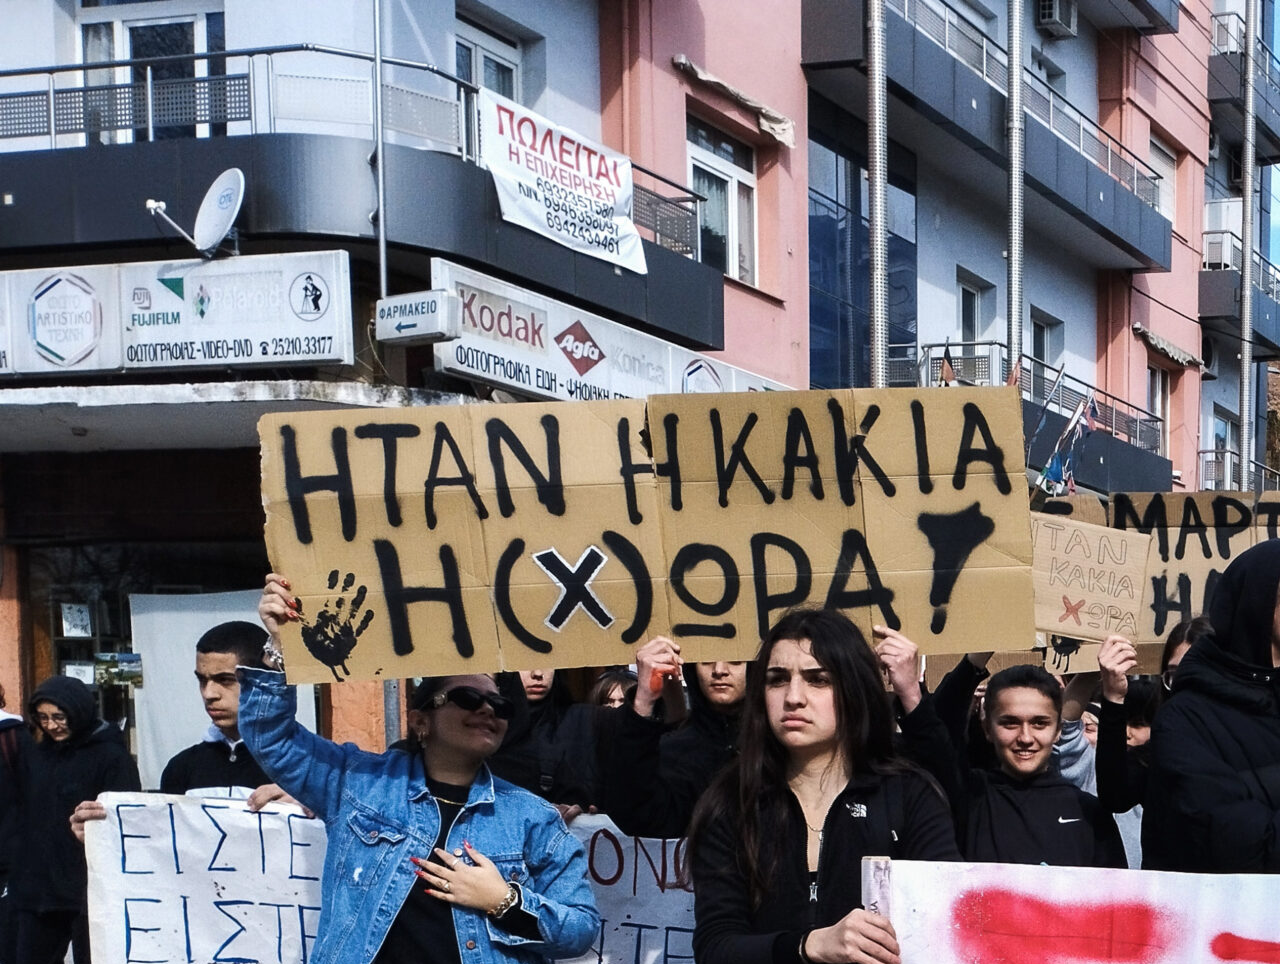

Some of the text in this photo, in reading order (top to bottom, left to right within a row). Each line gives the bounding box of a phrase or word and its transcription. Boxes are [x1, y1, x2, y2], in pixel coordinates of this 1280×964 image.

[496, 103, 622, 189] ΠΩΛΕΙΤΑΙ
[508, 143, 618, 205] Η ΕΠΙΧΕΙΡΗΣΗ
[131, 312, 181, 327] FUJIFILM
[379, 300, 437, 320] ΦΑΡΜΑΚΕΙΟ
[459, 288, 545, 349] Kodak
[271, 336, 334, 355] 25210.33177
[456, 344, 532, 386] ΦΩΤΟΓΡΑΦΙΚΑ
[536, 367, 558, 393] ΕΙΔΗ
[559, 334, 601, 361] Agfa
[280, 414, 566, 544] ΗΤΑΝ
[709, 397, 1013, 508] ΚΑΚΙΑ
[1049, 556, 1135, 600] ΚΑΚΙΑ
[115, 803, 320, 882] ΕΙΣΤΕ
